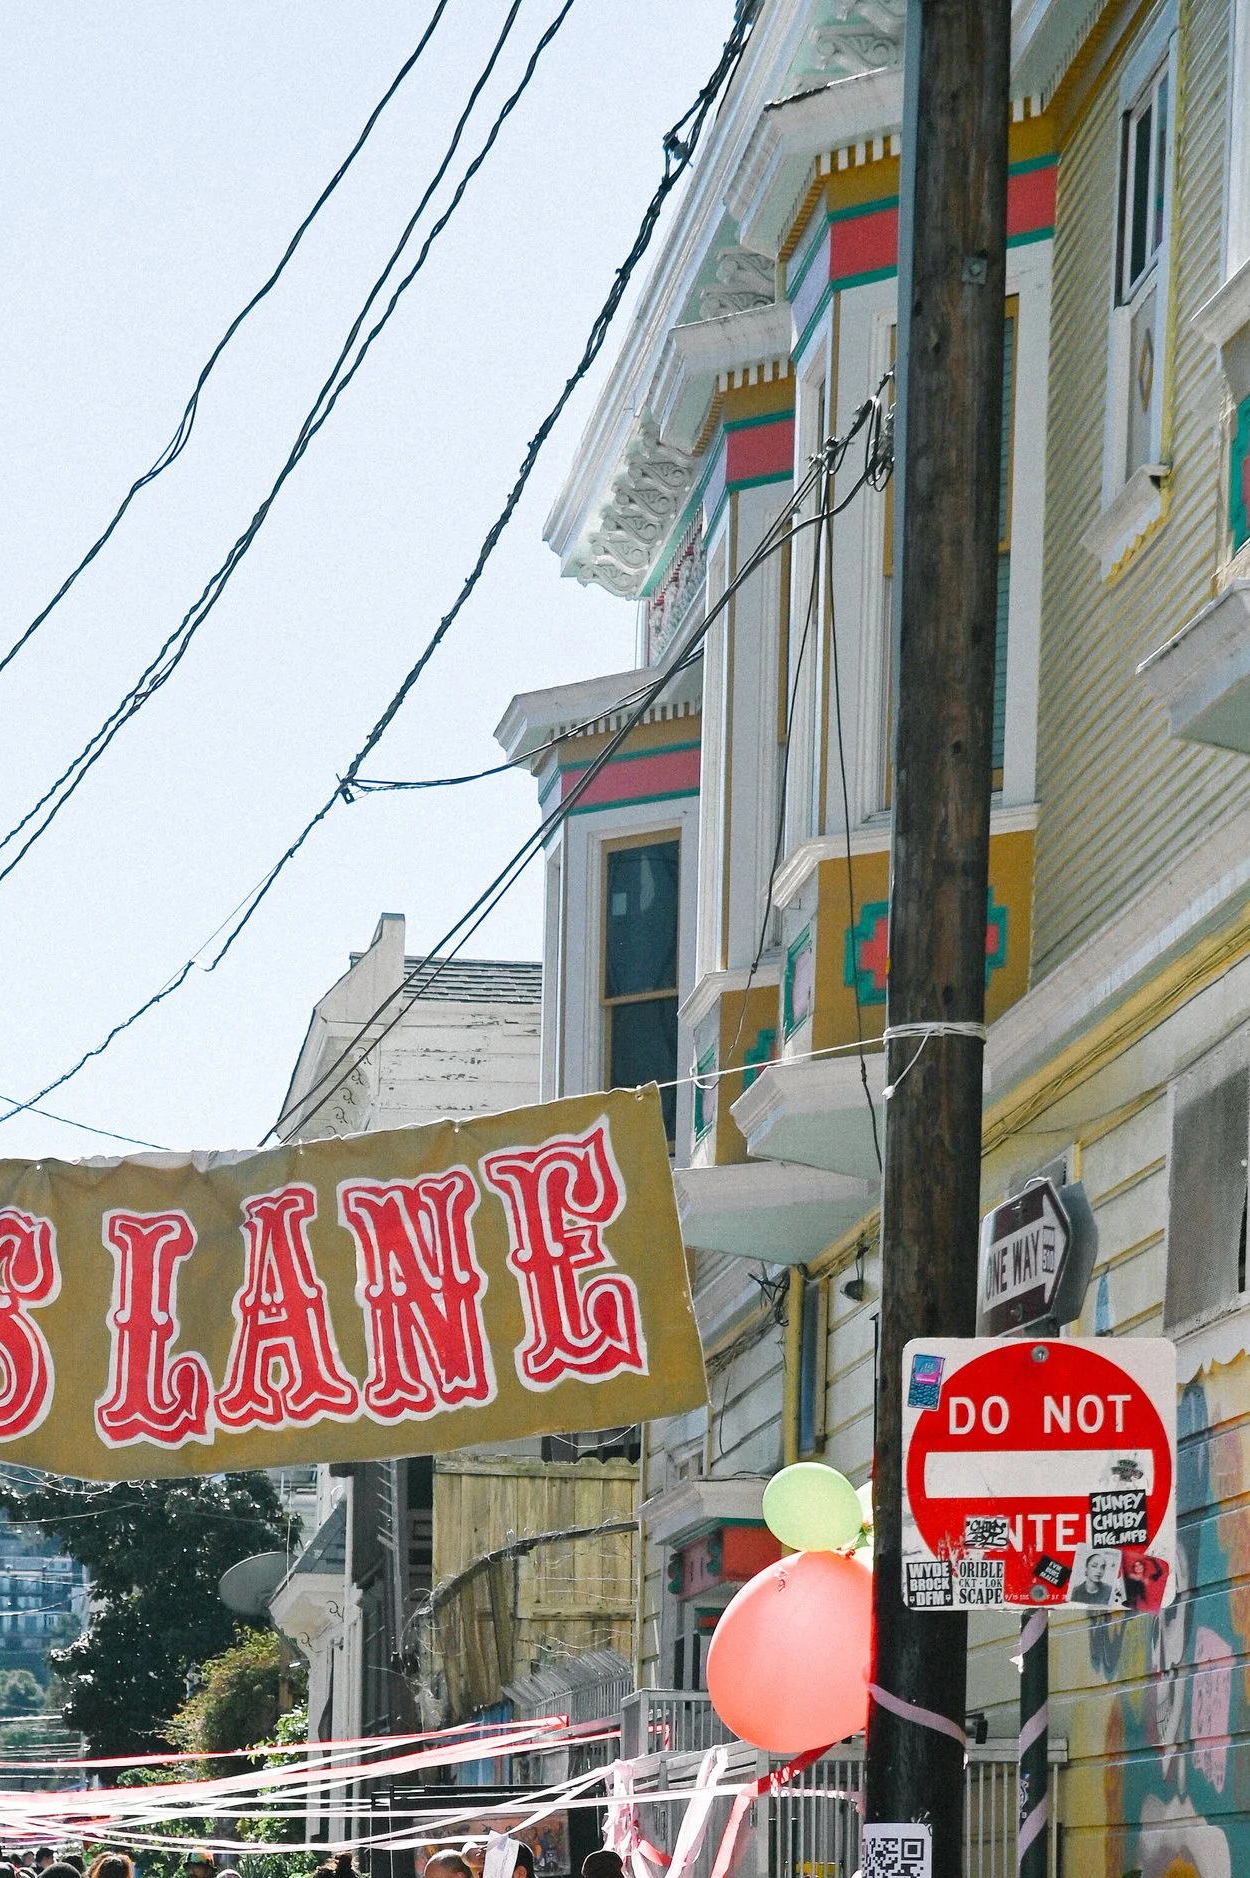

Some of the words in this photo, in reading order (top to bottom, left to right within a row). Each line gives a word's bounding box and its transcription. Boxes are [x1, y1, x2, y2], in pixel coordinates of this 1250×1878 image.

[986, 1246, 1008, 1301] ONE
[1012, 1229, 1040, 1287] WAY
[949, 1395, 1010, 1435] DO
[1043, 1394, 1132, 1434] NOT
[1092, 1492, 1144, 1513] JUNEY
[1092, 1510, 1146, 1531] CHUBY
[908, 1562, 950, 1578] WYDE
[959, 1561, 1004, 1578] ORIBLE
[909, 1577, 950, 1592] BROCK
[915, 1590, 945, 1606] DFM
[958, 1588, 1003, 1605] SCAPE
